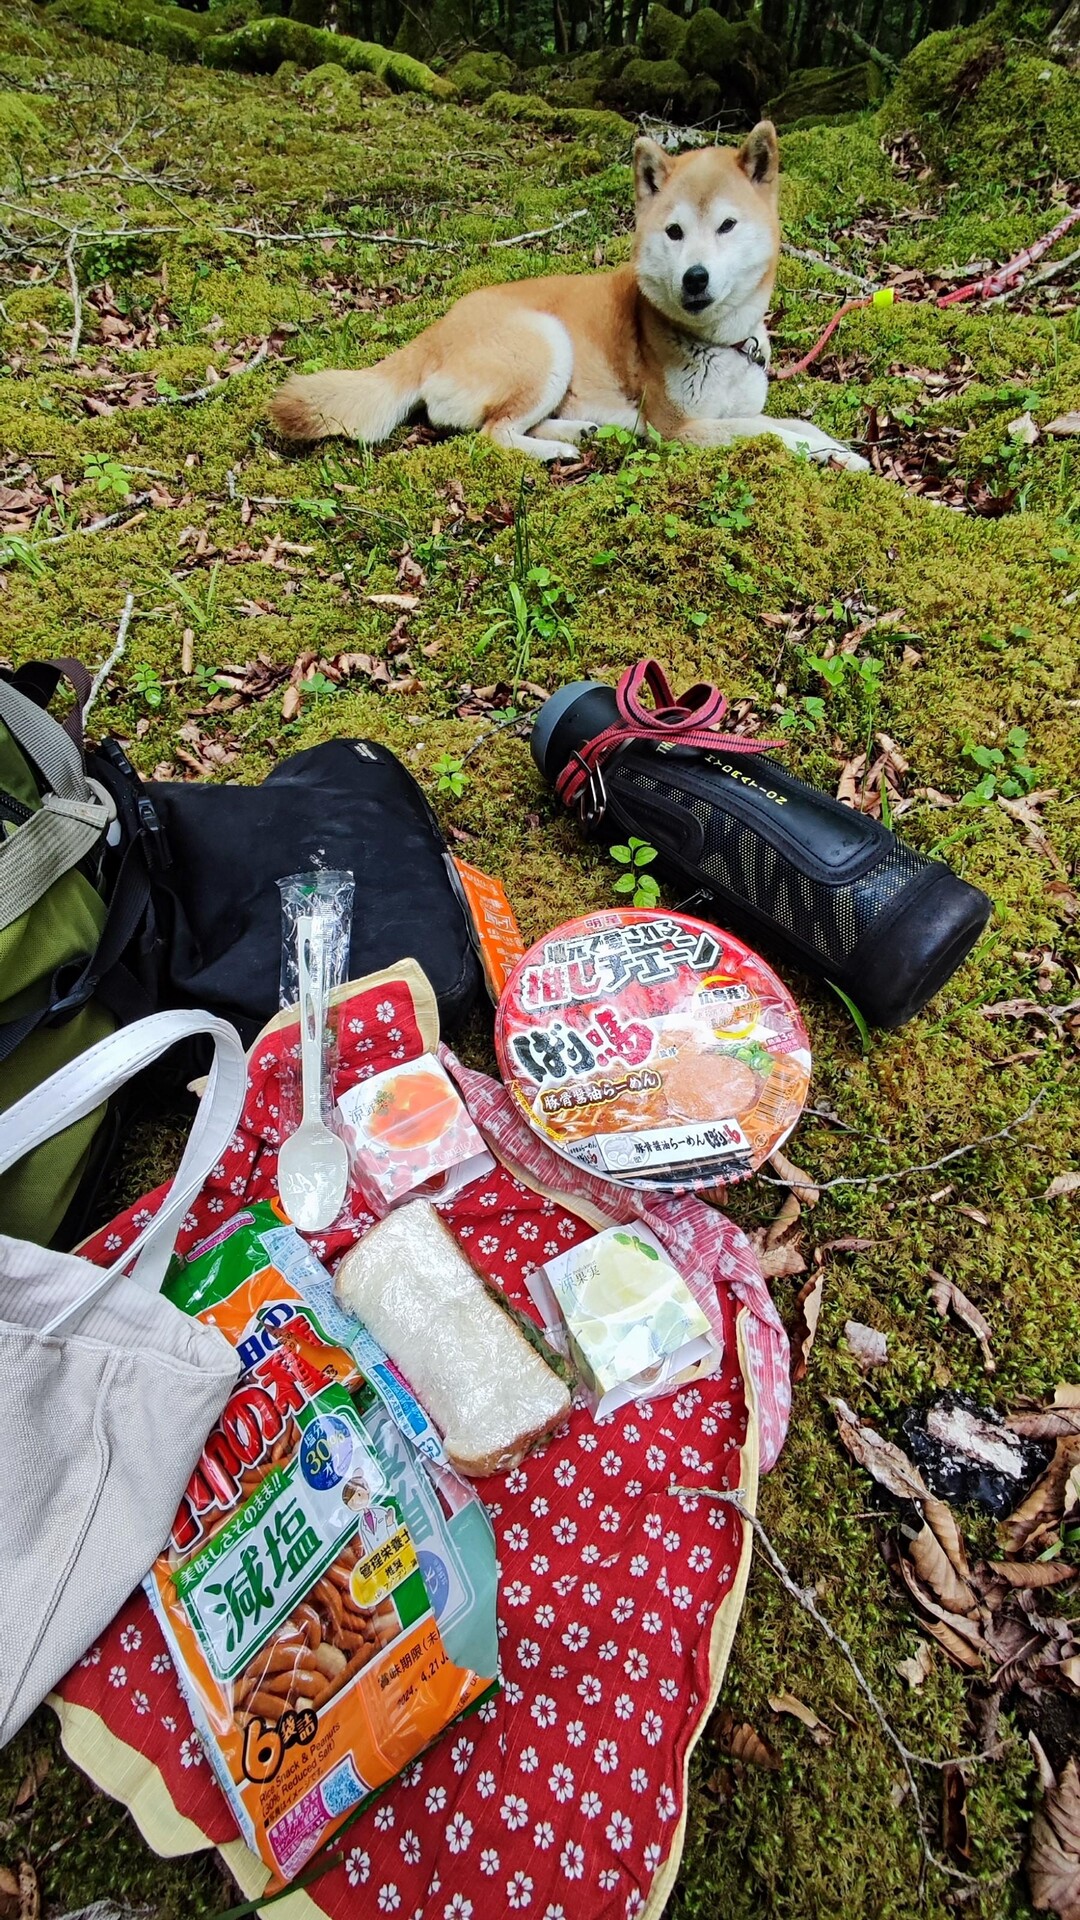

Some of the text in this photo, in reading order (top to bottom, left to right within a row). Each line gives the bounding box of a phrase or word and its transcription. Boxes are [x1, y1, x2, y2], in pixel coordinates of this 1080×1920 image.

[704, 754, 788, 806] HYDRATION
[586, 915, 620, 928] 明星
[543, 1071, 657, 1111] 豚骨醤油らーめん
[304, 1421, 324, 1450] 塩分
[204, 1497, 323, 1653] 減塩
[360, 1528, 411, 1580] 管理栄養士
[378, 1626, 442, 1691] 賞味期限(未
[260, 1722, 341, 1804] Rice Snack & Peanuts
[262, 1739, 335, 1818] (30% Reduced Salt)
